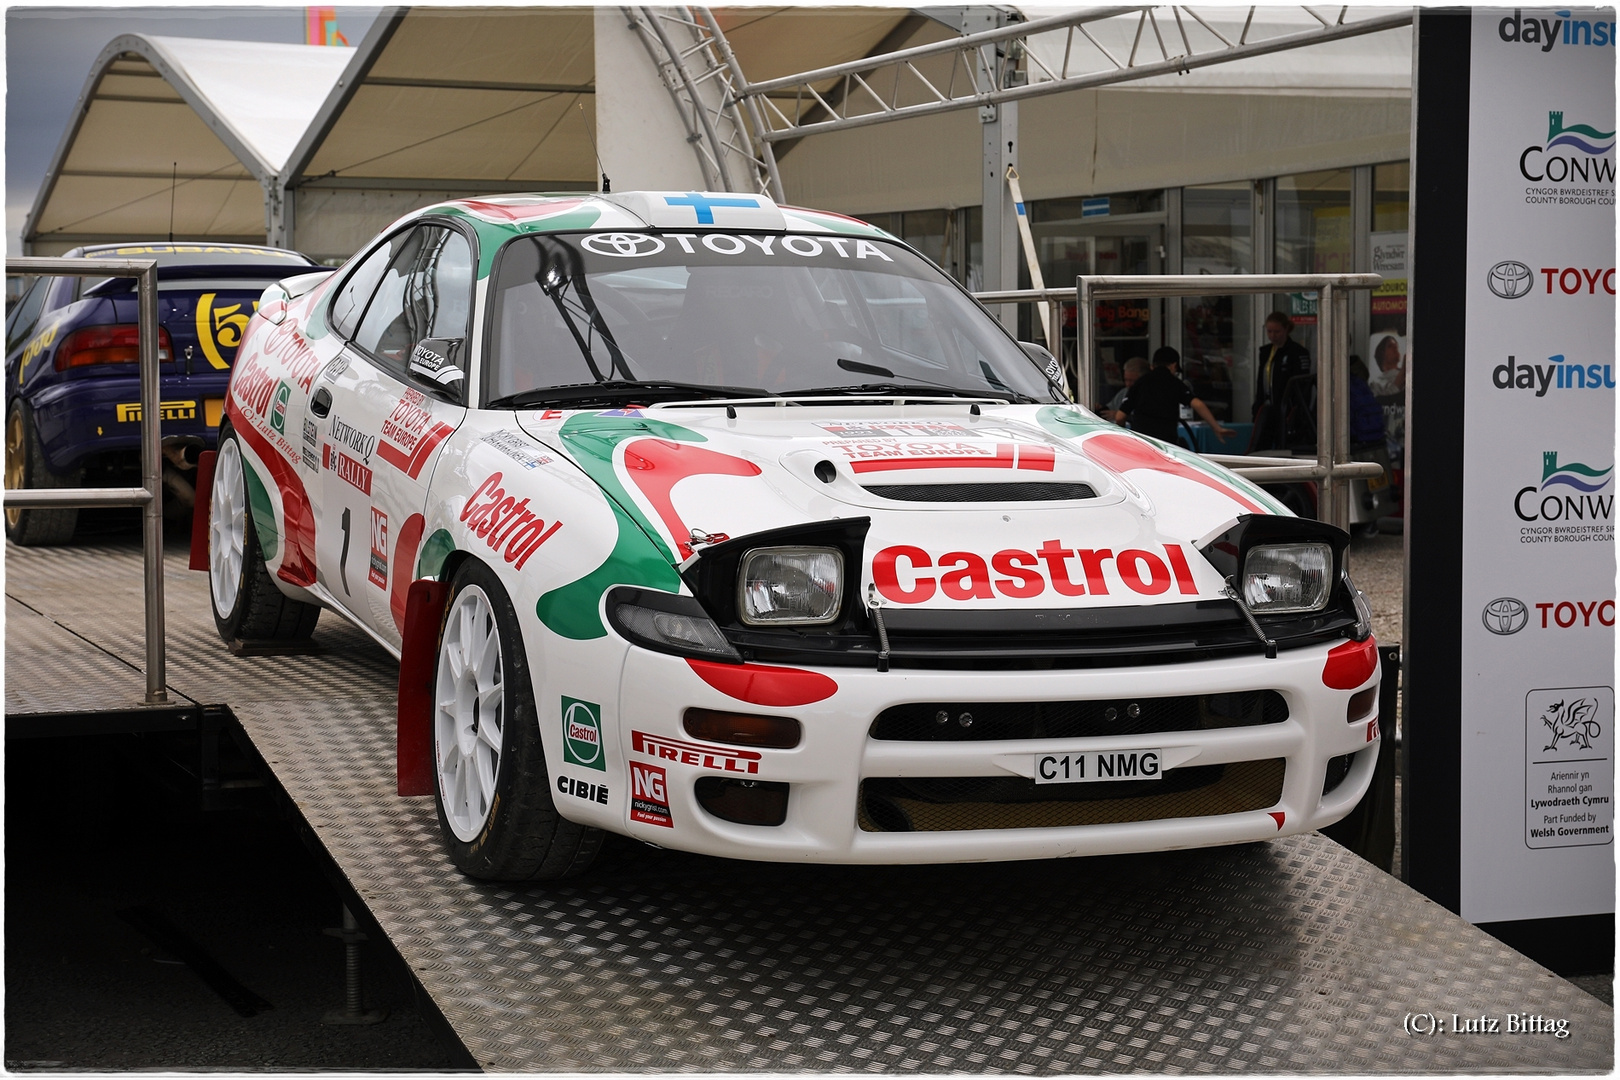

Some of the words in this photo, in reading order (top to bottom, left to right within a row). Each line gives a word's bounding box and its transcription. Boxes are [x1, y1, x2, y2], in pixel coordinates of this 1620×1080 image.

[1559, 197, 1596, 205] BOROUGH
[1560, 188, 1609, 196] BWRDEISTREF
[662, 233, 894, 262] TOYOTA
[1118, 306, 1150, 321] Bang
[277, 331, 321, 395] TOYOTA
[414, 344, 445, 366] TOYOTA
[419, 357, 441, 371] EUROPE
[233, 352, 280, 419] Castrol
[116, 400, 196, 422] PIELLI
[389, 399, 431, 435] TOYOTA
[329, 415, 367, 455] NETWORK
[362, 435, 375, 466] Q
[380, 419, 398, 439] TEAM
[395, 429, 418, 451] EUROPE
[822, 438, 885, 446] PREPARED
[832, 443, 981, 453] TOYOTA
[843, 449, 904, 459] TEAM
[907, 449, 992, 457] EUROPE
[339, 455, 369, 492] RALLY
[459, 471, 563, 572] Castrol
[1520, 527, 1553, 535] CYNGOR
[1554, 526, 1604, 534] BWRDEISTREF
[371, 510, 387, 557] NG
[1520, 536, 1552, 544] COUNTY
[1554, 535, 1591, 543] BOROUGH
[340, 506, 351, 598] 1
[872, 539, 1200, 604] Castrol
[1535, 599, 1616, 629] TOYO
[569, 723, 597, 743] Castrol
[631, 730, 762, 775] PIRELLI
[1039, 756, 1086, 780] C11
[1097, 752, 1159, 777] NMG
[1550, 772, 1579, 781] Ariennir
[1580, 771, 1590, 781] yn
[633, 766, 665, 803] NG
[1547, 784, 1577, 794] Rhannol
[1578, 784, 1593, 794] gan
[1530, 796, 1580, 809] Lywodraeth
[1582, 795, 1609, 806] Cymru
[1543, 815, 1558, 824] Part
[1559, 813, 1586, 823] Funded
[1587, 812, 1597, 823] by
[1530, 827, 1555, 838] Welsh
[1557, 825, 1609, 836] Government
